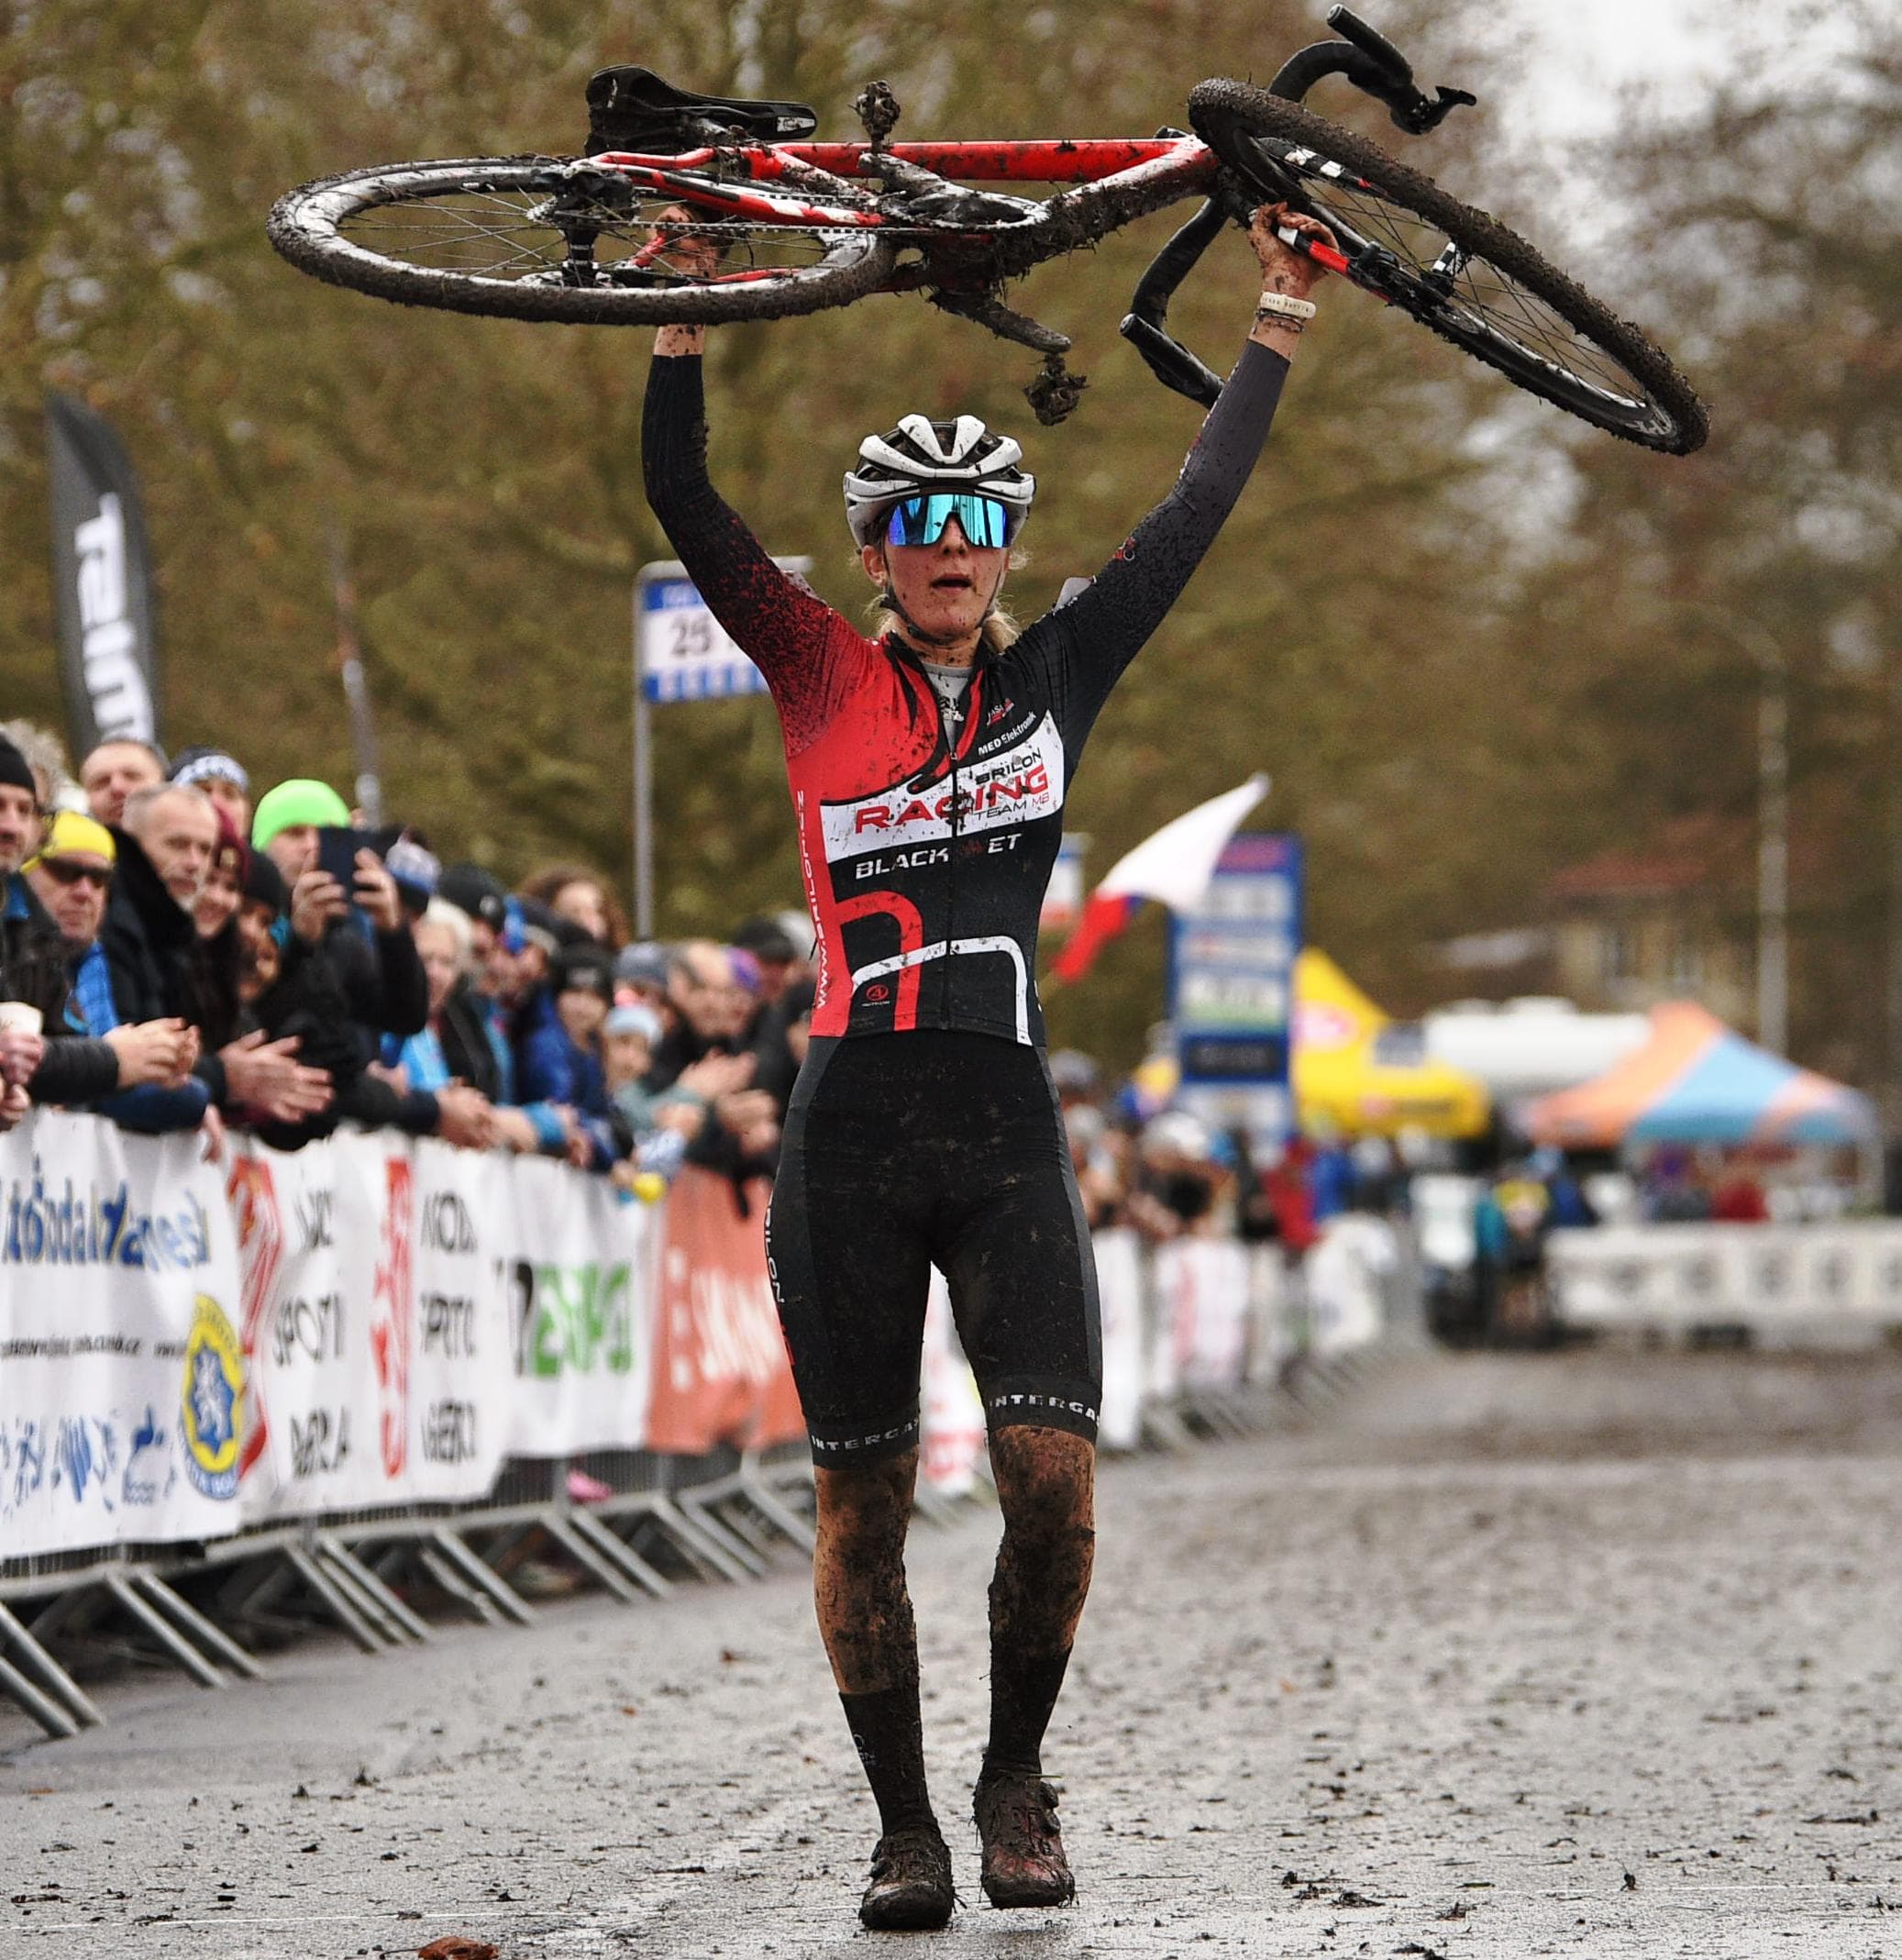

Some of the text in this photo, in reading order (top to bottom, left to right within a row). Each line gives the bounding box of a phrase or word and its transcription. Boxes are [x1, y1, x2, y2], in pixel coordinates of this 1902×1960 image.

[978, 739, 1001, 756] MED
[975, 747, 1042, 784] BRILON
[855, 762, 1048, 834] RACING
[974, 800, 1027, 820] TEAM
[855, 847, 949, 880] BLACK
